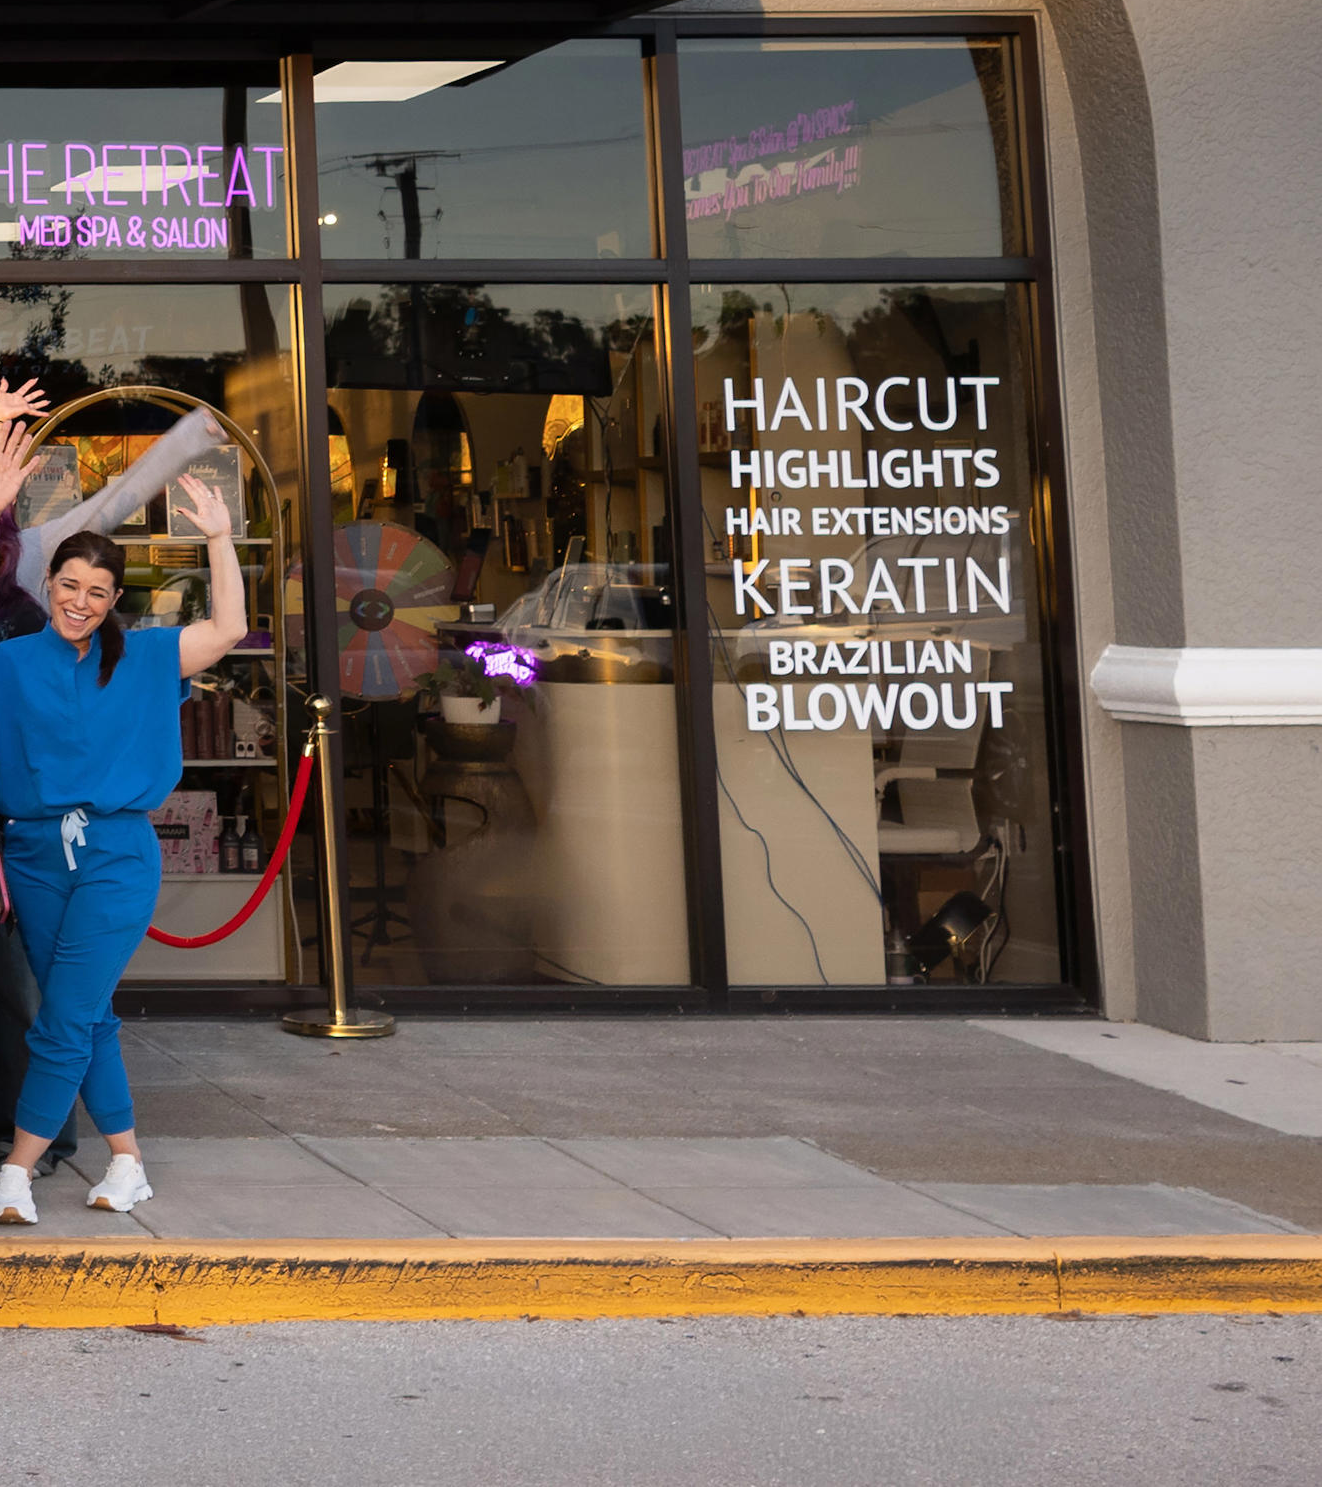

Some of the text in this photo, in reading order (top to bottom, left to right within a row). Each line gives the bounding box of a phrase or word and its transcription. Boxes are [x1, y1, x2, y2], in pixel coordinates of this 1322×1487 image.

[65, 144, 284, 207] RETREAT
[19, 215, 228, 249] MED SPA & SALON
[723, 377, 999, 431] HAIRCUT
[731, 449, 1000, 489] HIGHLIGHTS
[726, 505, 1009, 536] HAIR EXTENSIONS
[733, 557, 1010, 615] KERATIN
[769, 640, 971, 675] BRAZILIAN
[746, 682, 1013, 731] BLOWOUT
